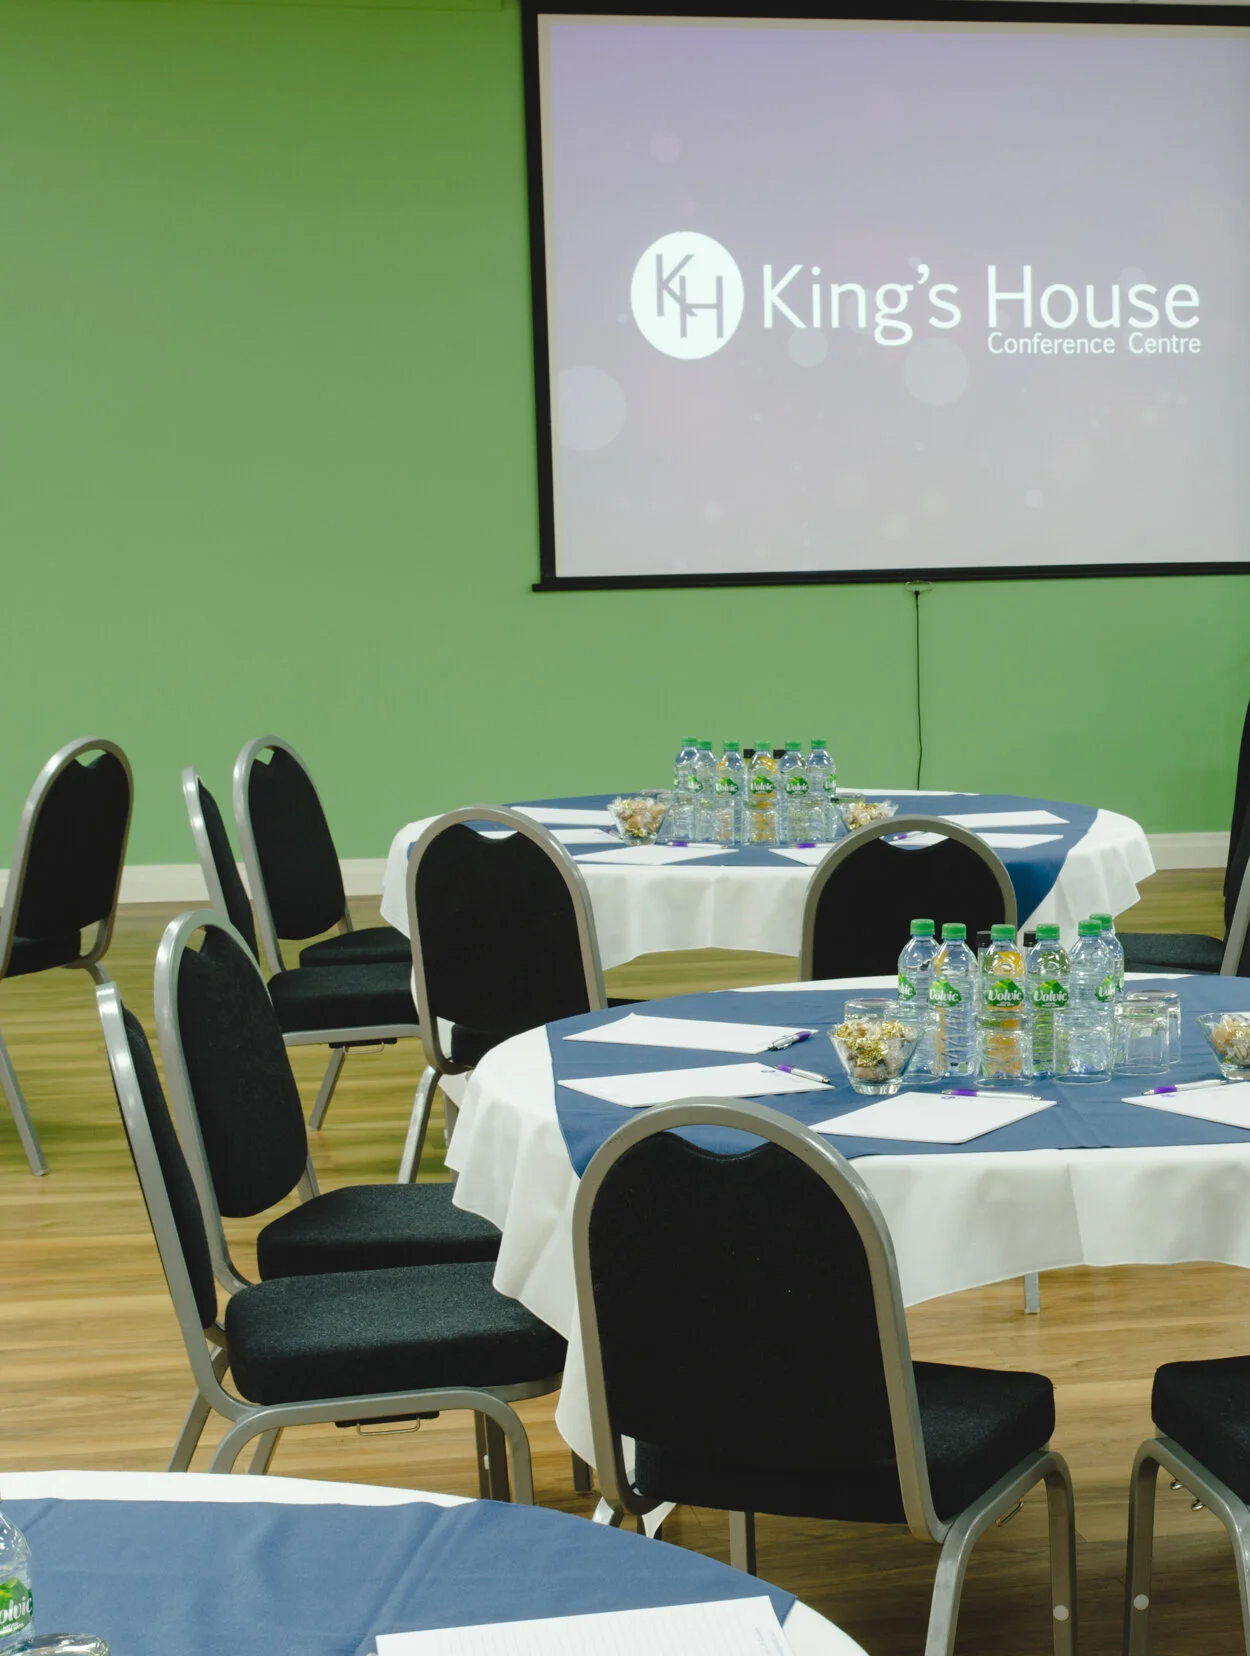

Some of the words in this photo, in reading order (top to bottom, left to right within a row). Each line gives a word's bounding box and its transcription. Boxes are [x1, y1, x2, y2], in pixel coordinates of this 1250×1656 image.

[762, 263, 962, 346] King's
[987, 264, 1201, 329] House
[987, 331, 1116, 354] Conference
[1128, 331, 1201, 354] Centre
[929, 987, 959, 1002] Volvic
[988, 989, 1023, 1001] Volvic
[1033, 990, 1068, 1002] Volvic
[0, 1596, 32, 1624] olvic
